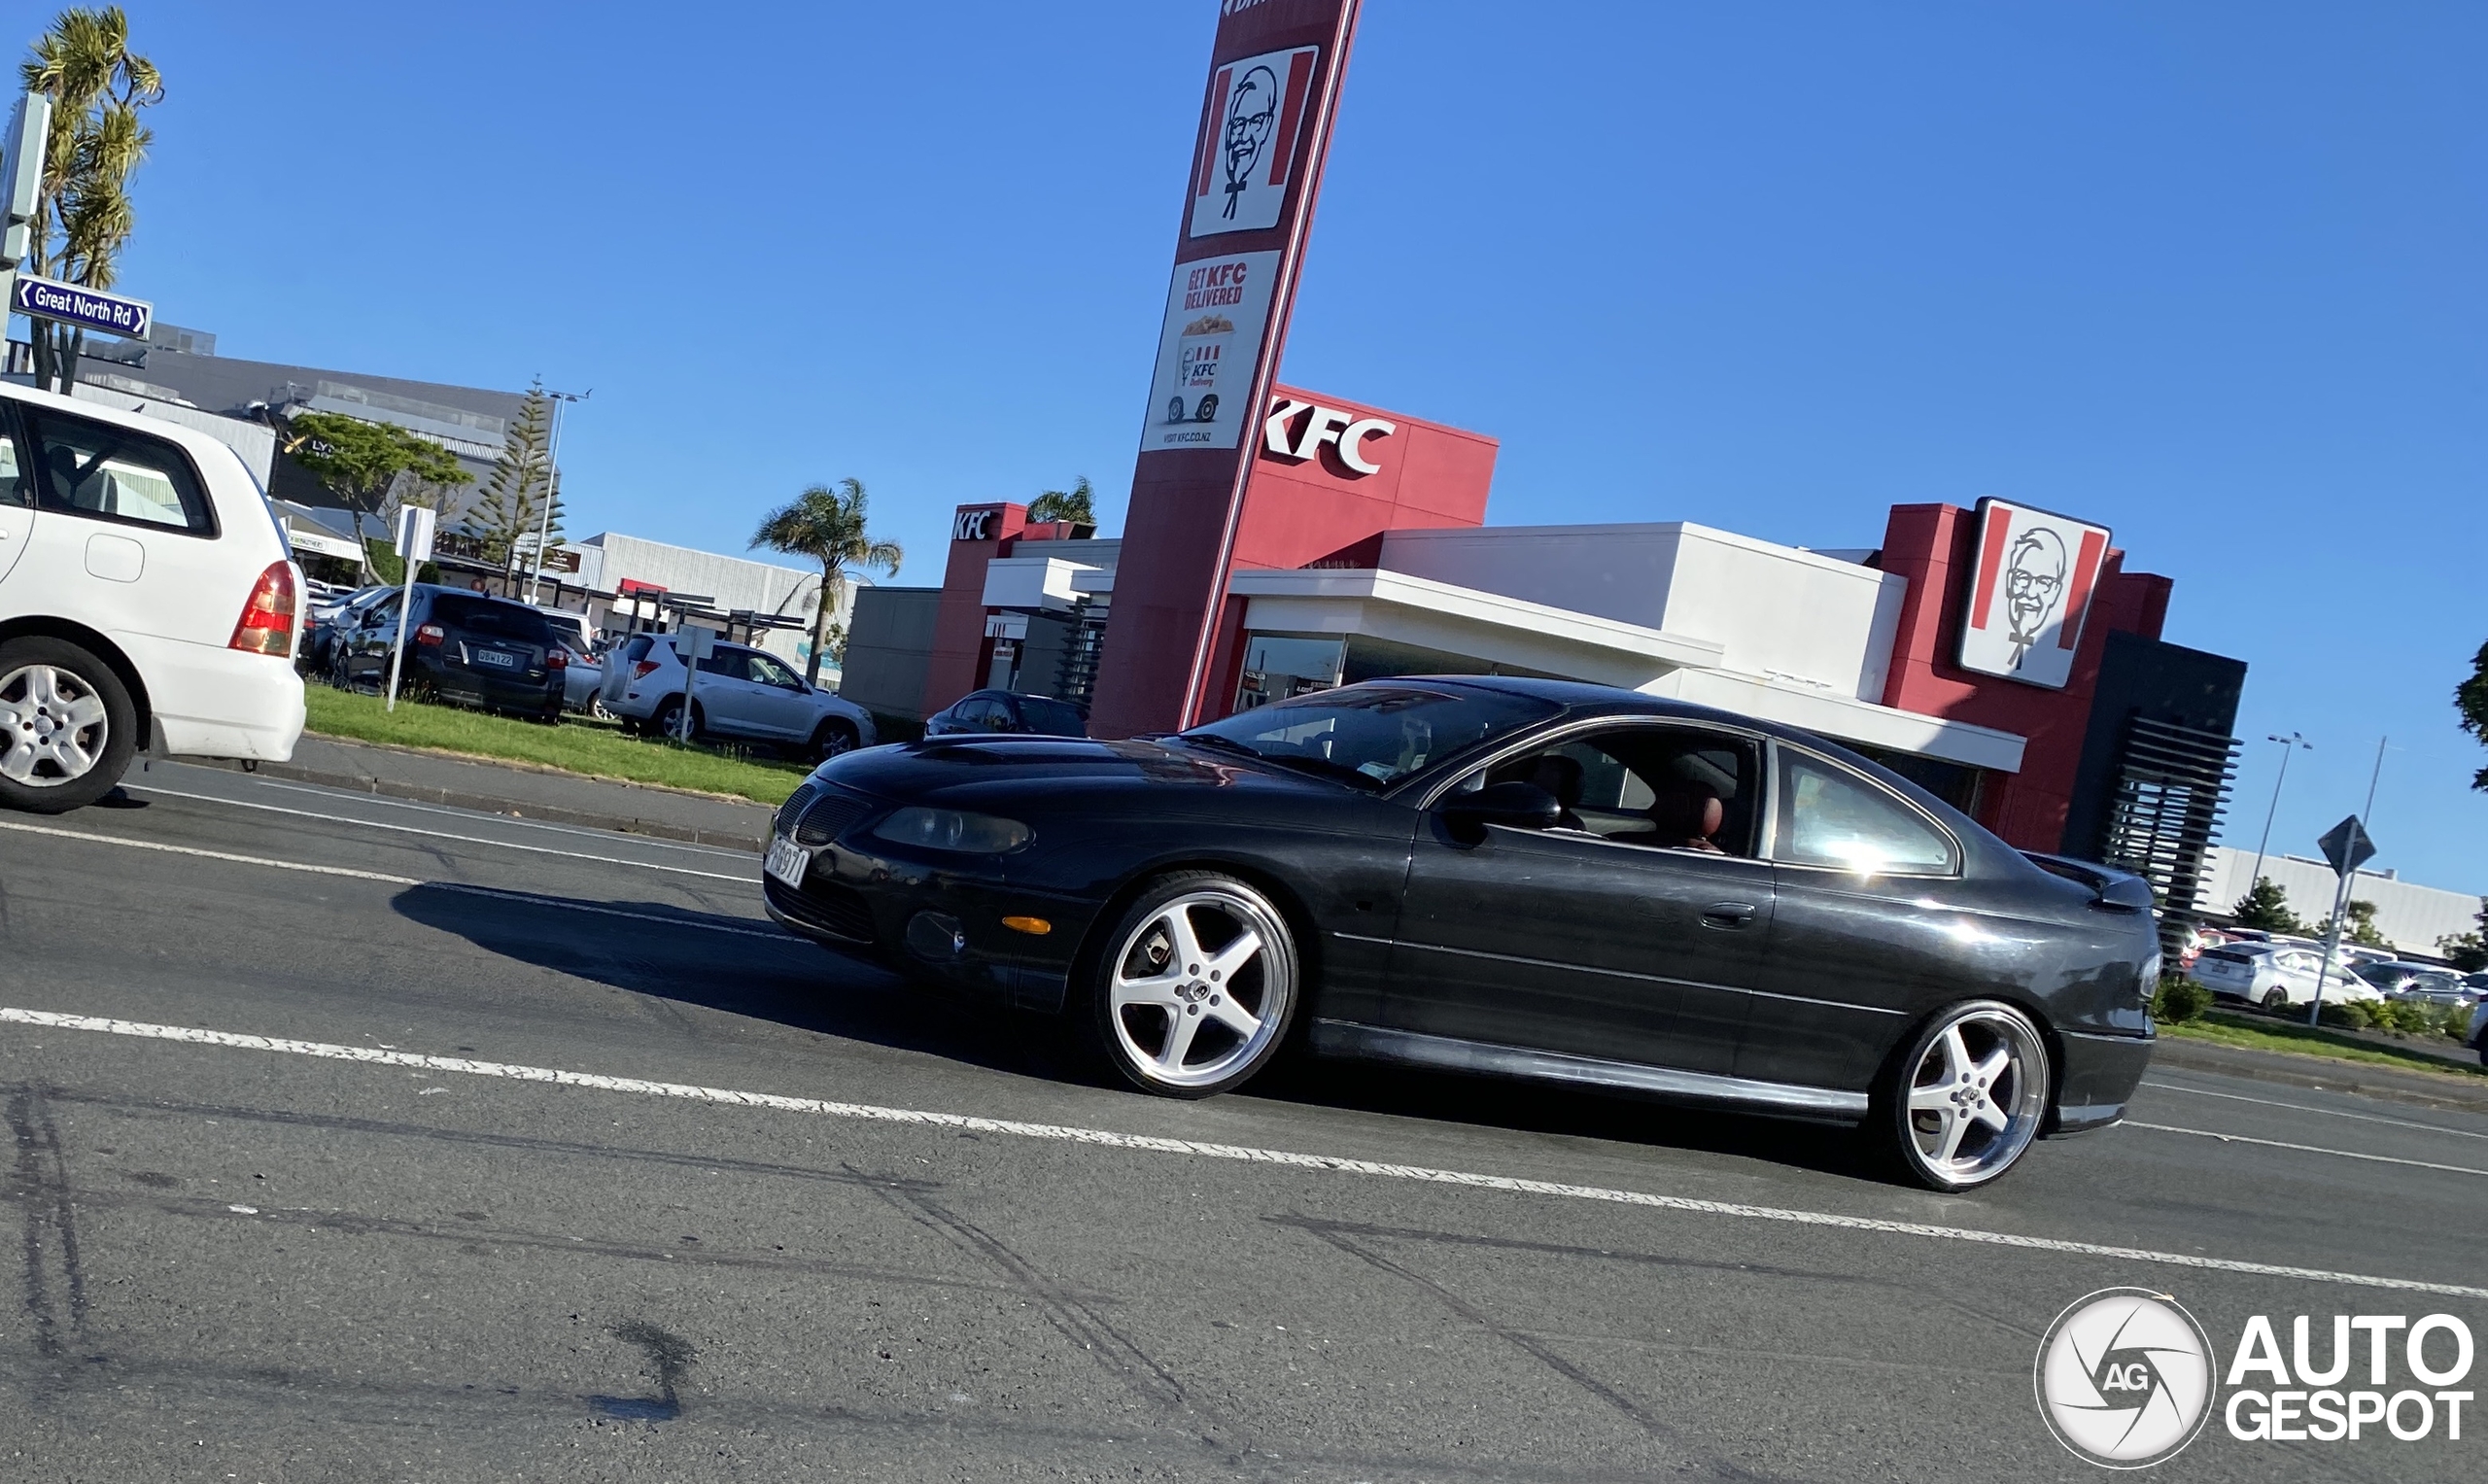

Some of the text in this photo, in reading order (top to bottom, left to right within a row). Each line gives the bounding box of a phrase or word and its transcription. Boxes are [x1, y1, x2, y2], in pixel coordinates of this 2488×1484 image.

[1188, 262, 1247, 291] GET KFC
[35, 287, 131, 326] Great North Rd
[1185, 286, 1242, 310] DELIVERED
[1192, 363, 1217, 377] KFC
[1265, 396, 1397, 475] KFC
[952, 511, 990, 539] KFC
